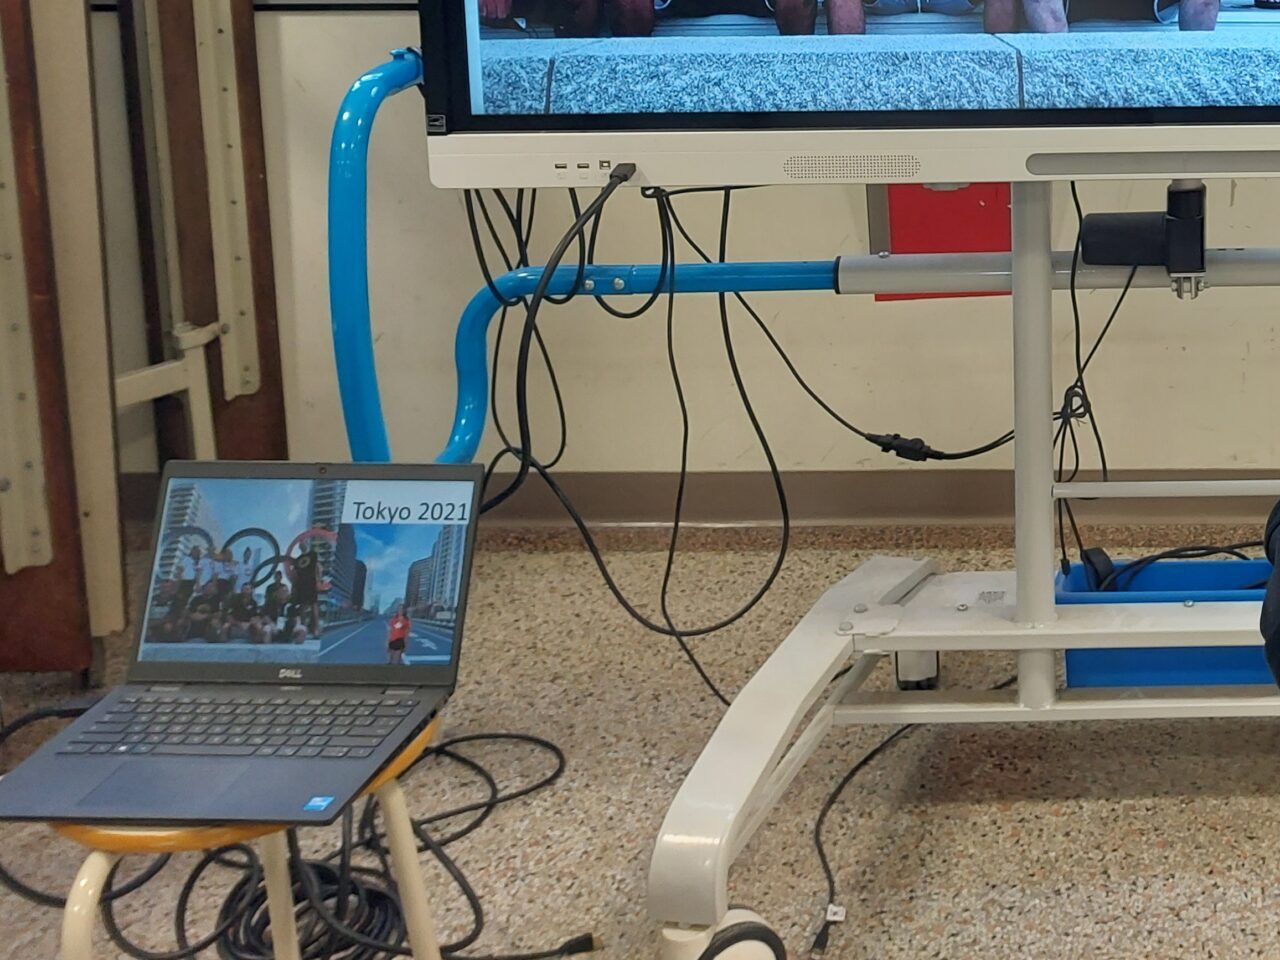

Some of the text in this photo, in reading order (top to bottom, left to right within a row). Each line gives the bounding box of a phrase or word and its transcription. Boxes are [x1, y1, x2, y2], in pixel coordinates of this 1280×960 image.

[353, 501, 468, 524] Tokyo 2021
[278, 668, 303, 679] DELL
